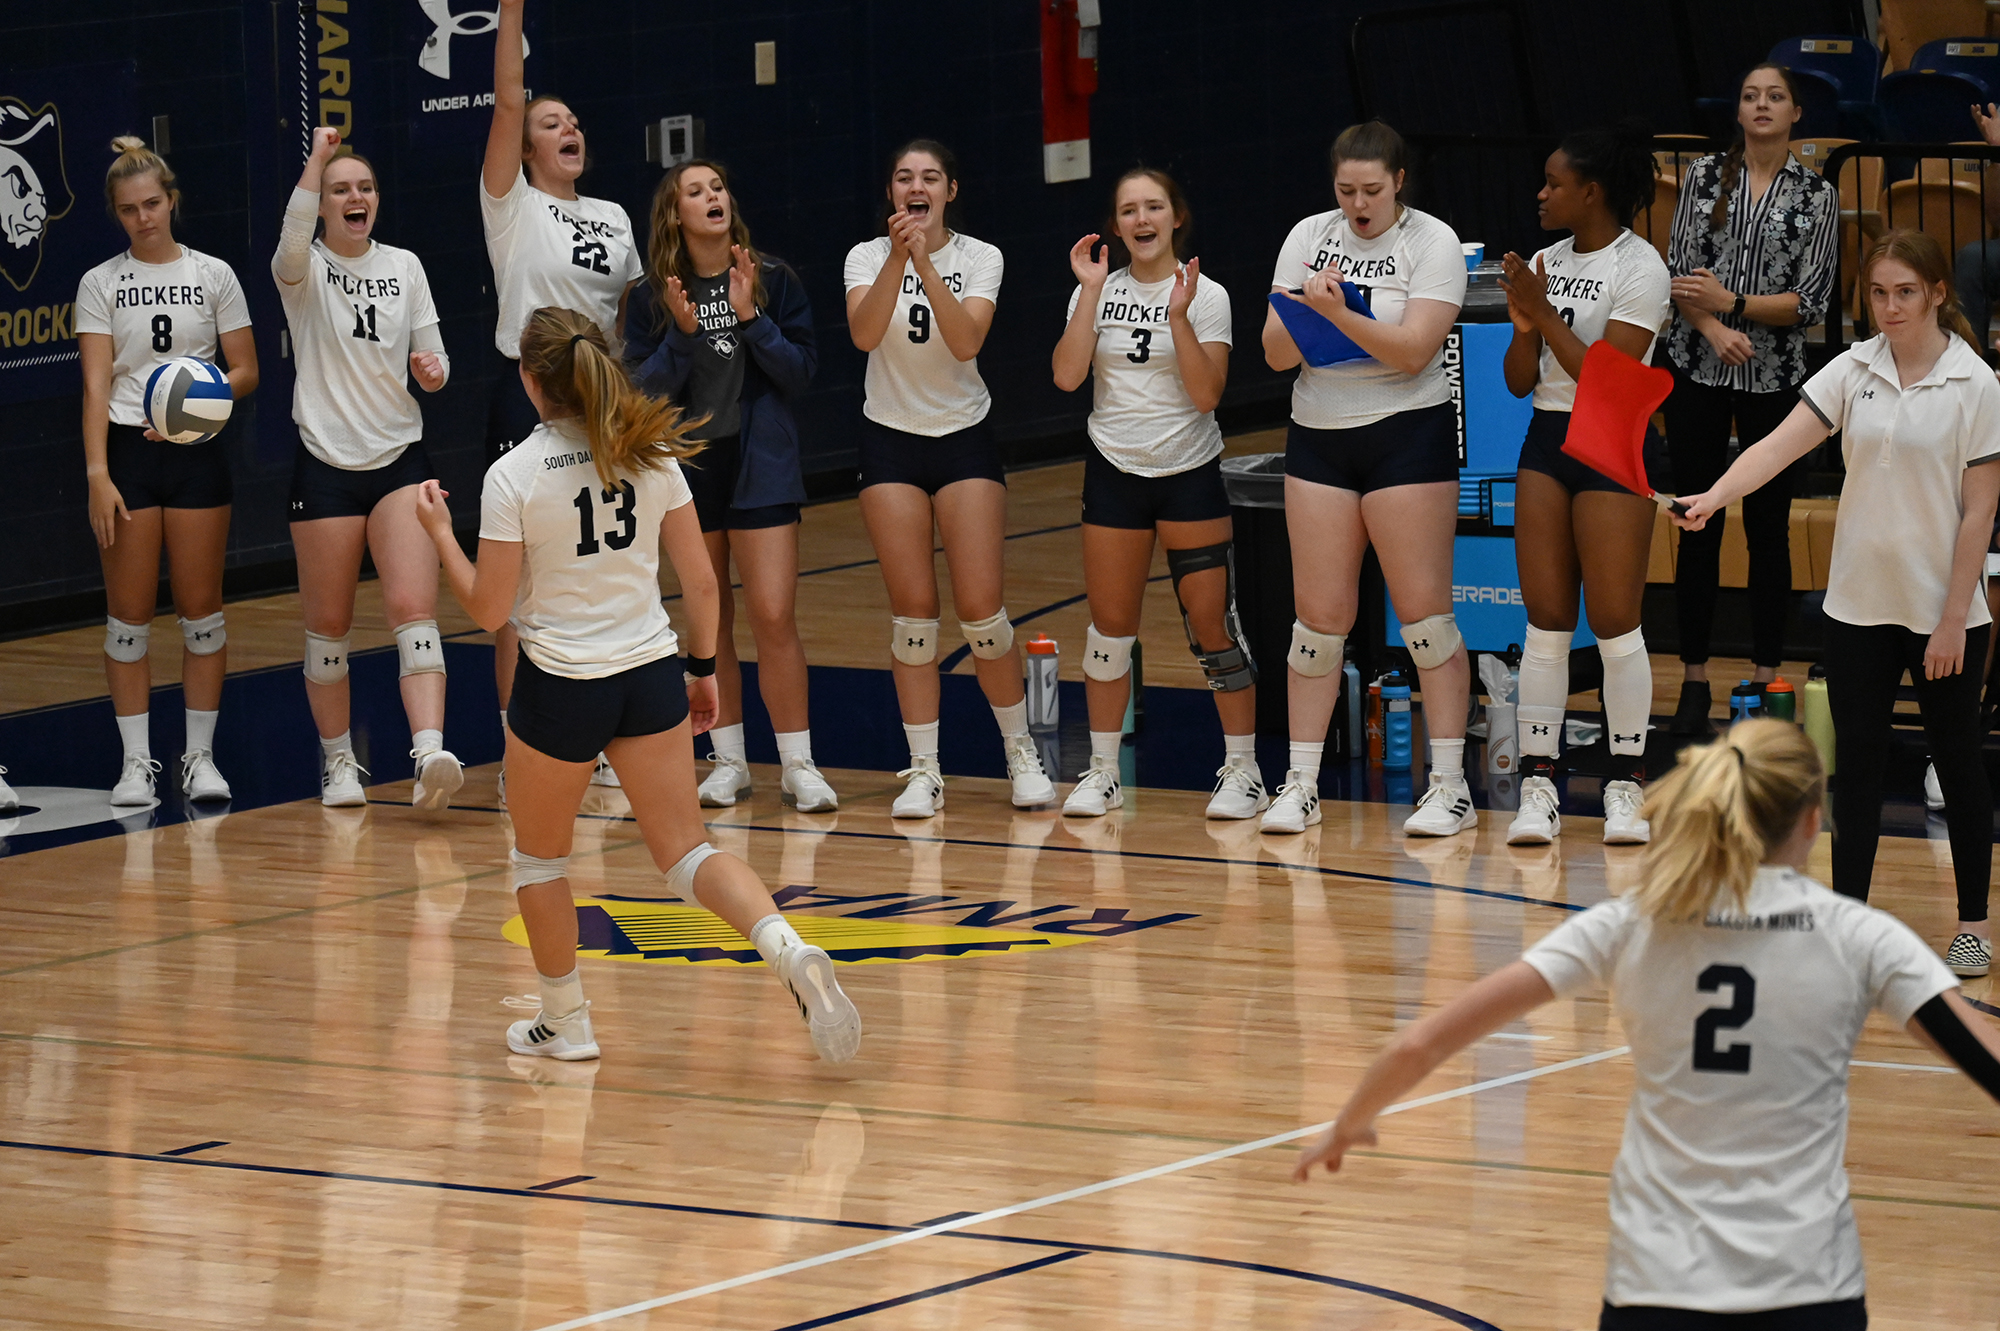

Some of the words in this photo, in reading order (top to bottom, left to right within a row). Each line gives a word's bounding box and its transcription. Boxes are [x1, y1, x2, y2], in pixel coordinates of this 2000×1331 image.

[422, 96, 469, 112] UNDER
[571, 231, 611, 276] 22
[115, 285, 205, 309] ROCKERS
[325, 260, 400, 298] RCERS
[1546, 274, 1603, 301] OCKERS
[151, 314, 173, 353] 8
[352, 303, 381, 342] 11
[698, 314, 738, 331] LLEYBA
[908, 303, 930, 344] 9
[1126, 328, 1152, 364] 3
[544, 453, 576, 470] SOUTH
[573, 478, 637, 557] 13
[1767, 912, 1814, 932] MINES
[1692, 963, 1756, 1074] 2
